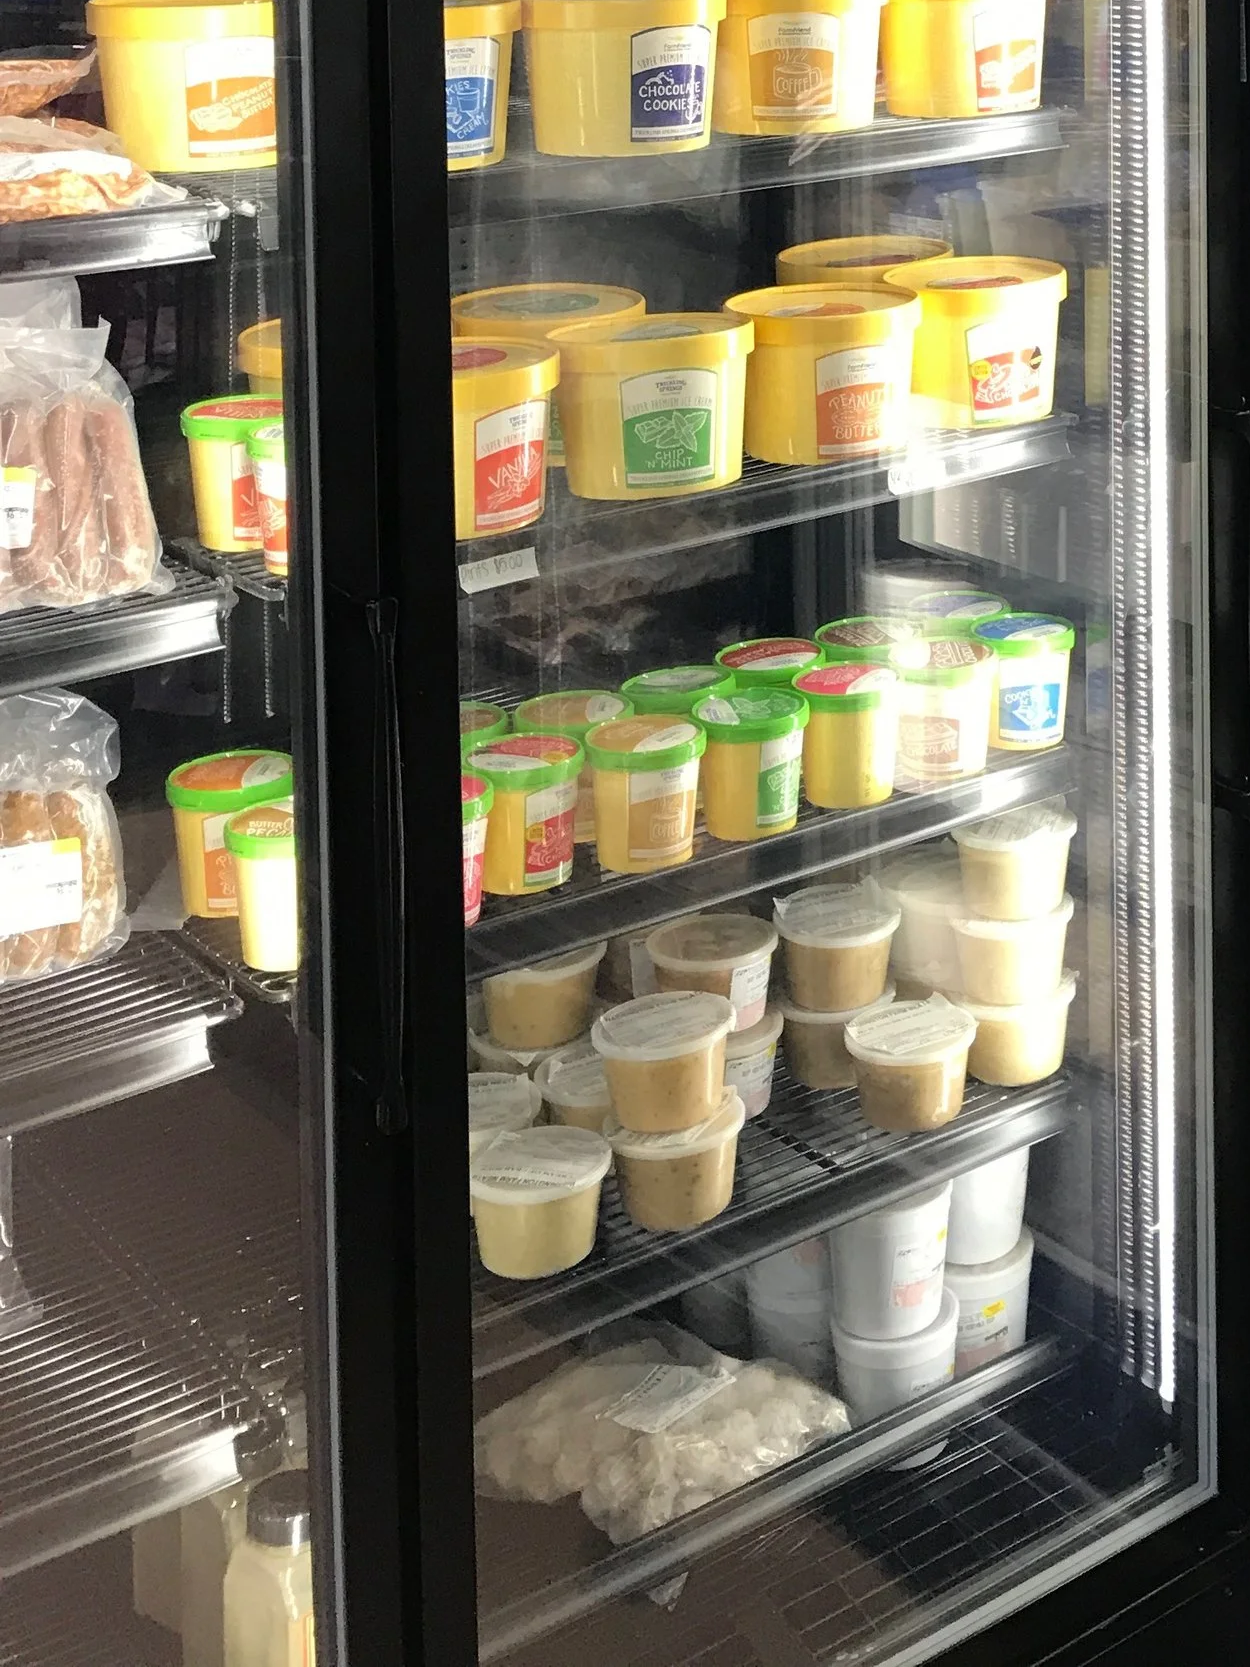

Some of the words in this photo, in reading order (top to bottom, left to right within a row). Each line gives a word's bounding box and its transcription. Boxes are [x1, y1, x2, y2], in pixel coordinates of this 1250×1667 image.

[639, 81, 701, 98] CHOCOLAE
[776, 77, 809, 94] COFFEE
[829, 388, 885, 410] PEANUT
[655, 448, 684, 460] CHIP
[660, 457, 692, 469] MINT
